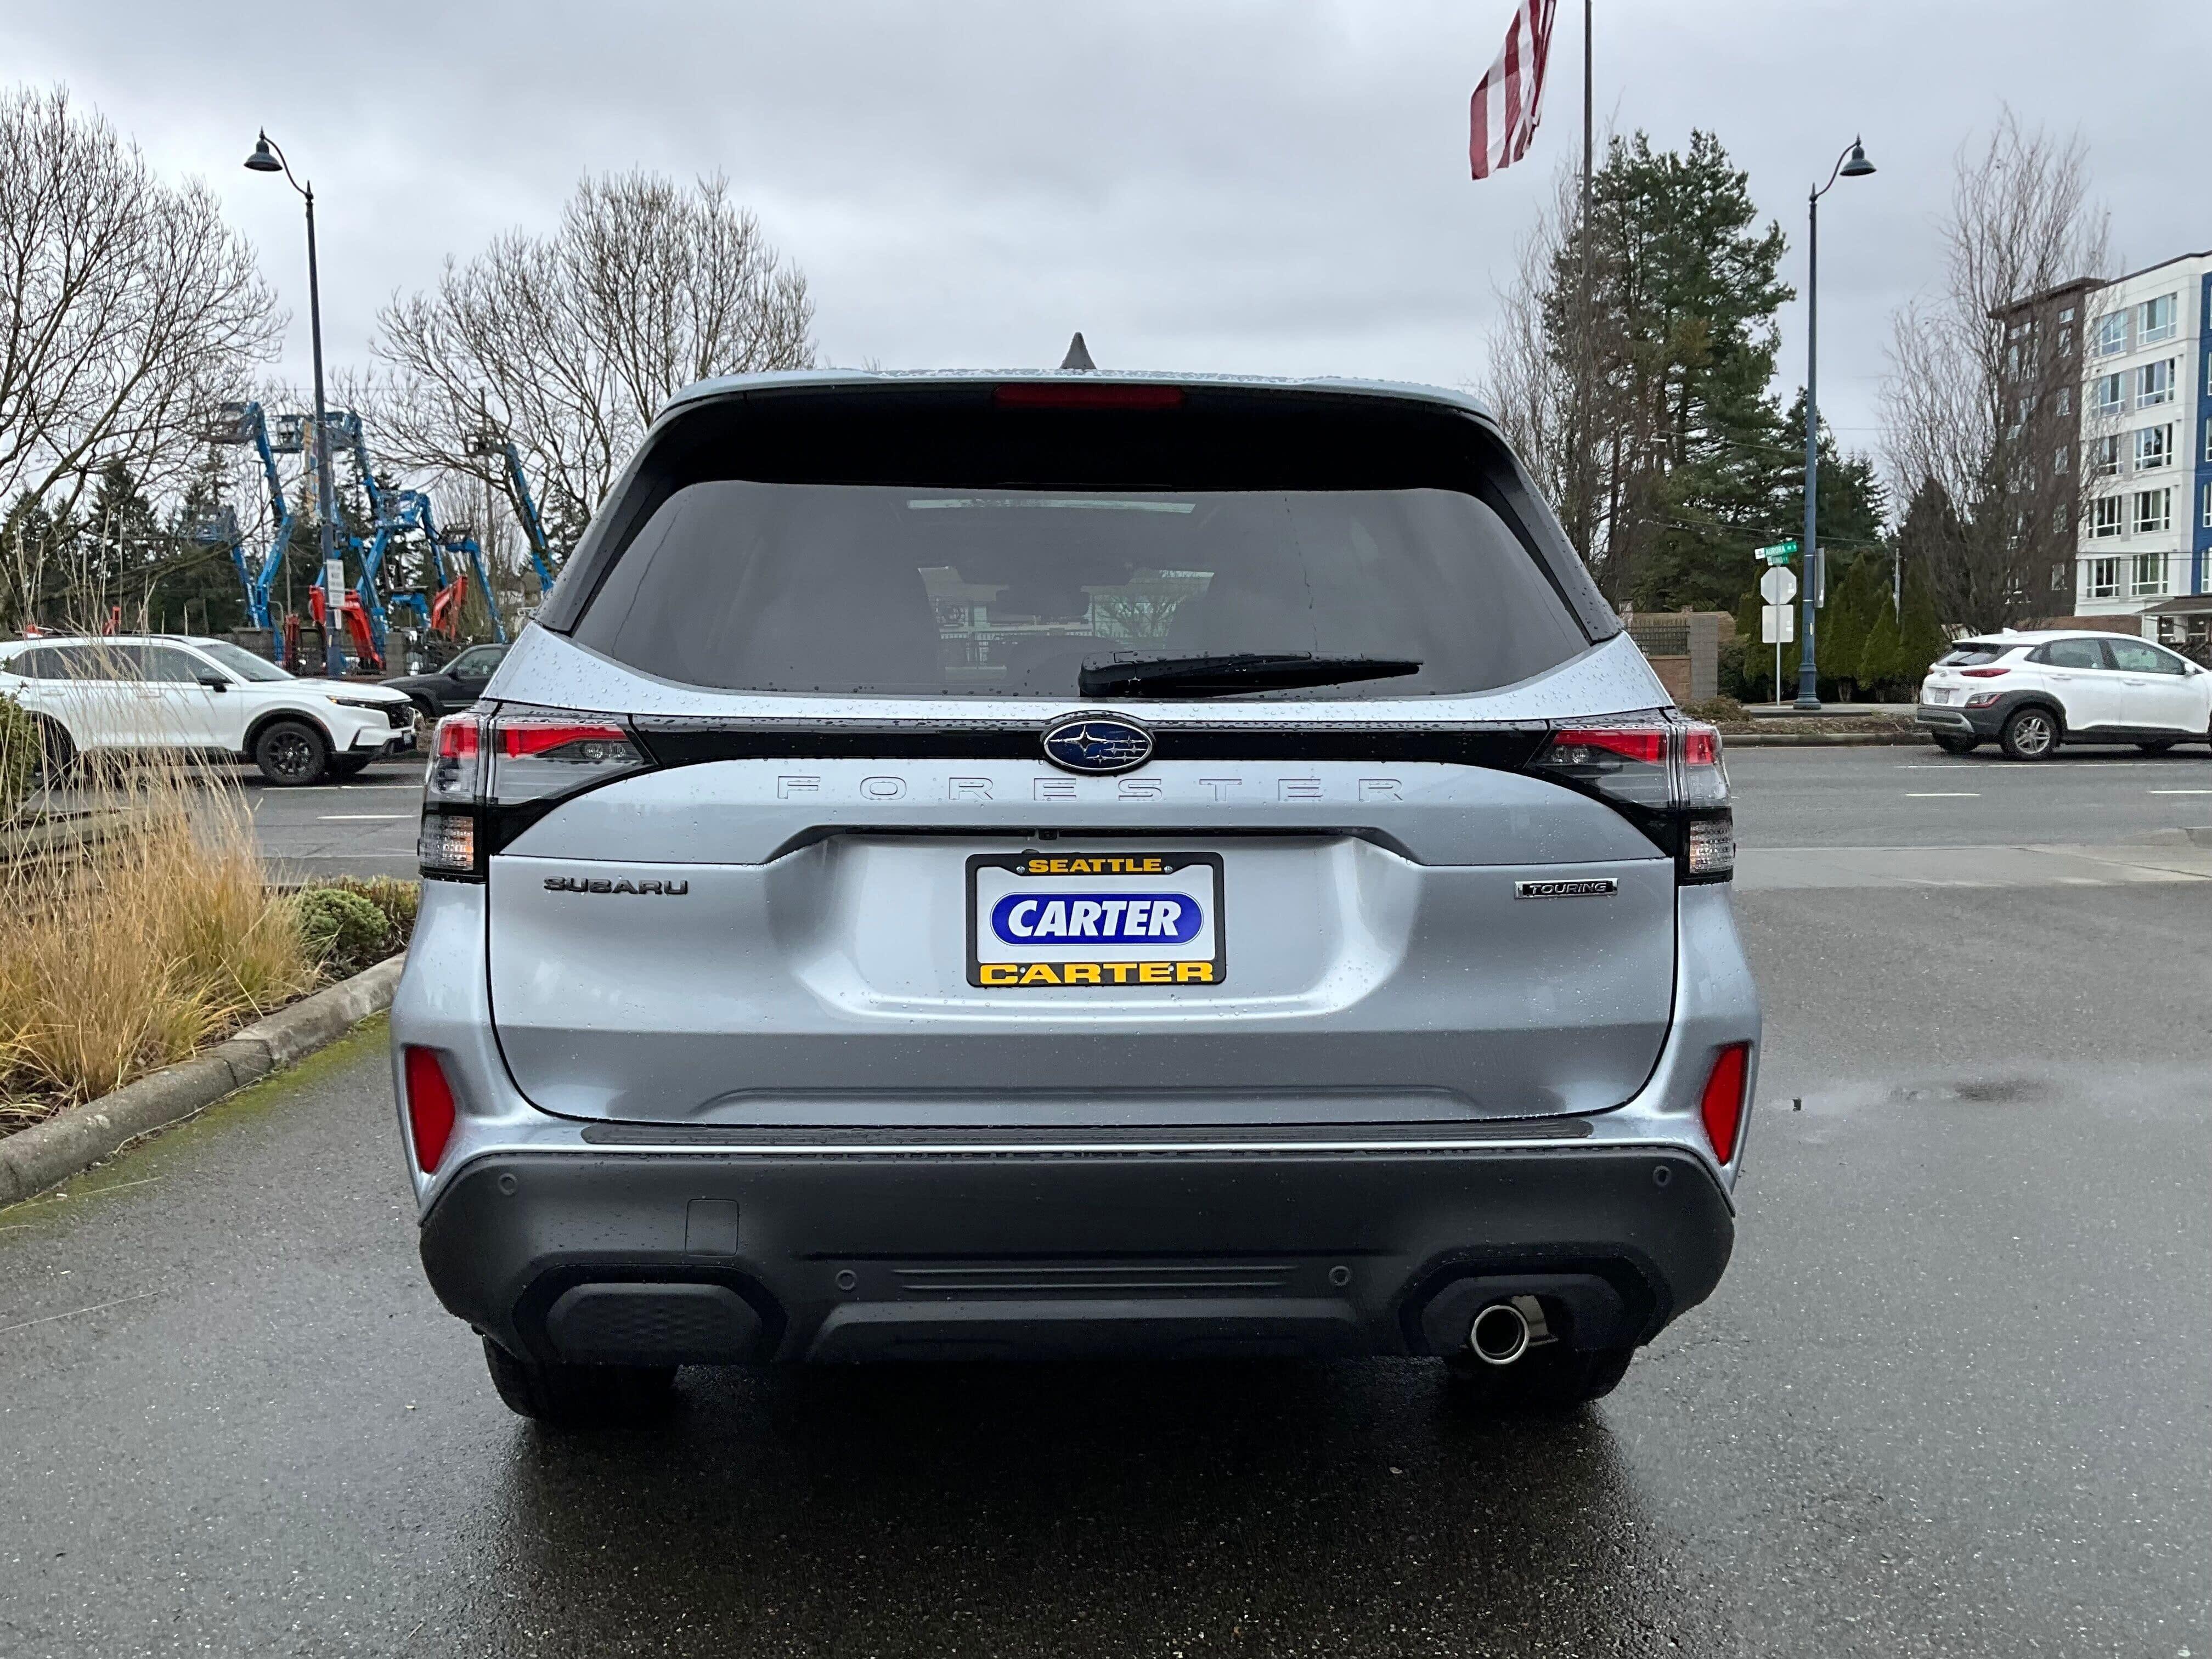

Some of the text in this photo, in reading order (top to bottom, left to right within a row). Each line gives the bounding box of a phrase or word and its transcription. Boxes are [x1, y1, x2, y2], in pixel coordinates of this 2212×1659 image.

[777, 775, 1403, 802] FORESTER
[1028, 859, 1162, 873] SEATTLE
[544, 876, 689, 895] SUBARU
[1008, 900, 1181, 936] CARTER
[980, 962, 1214, 984] CARTER
